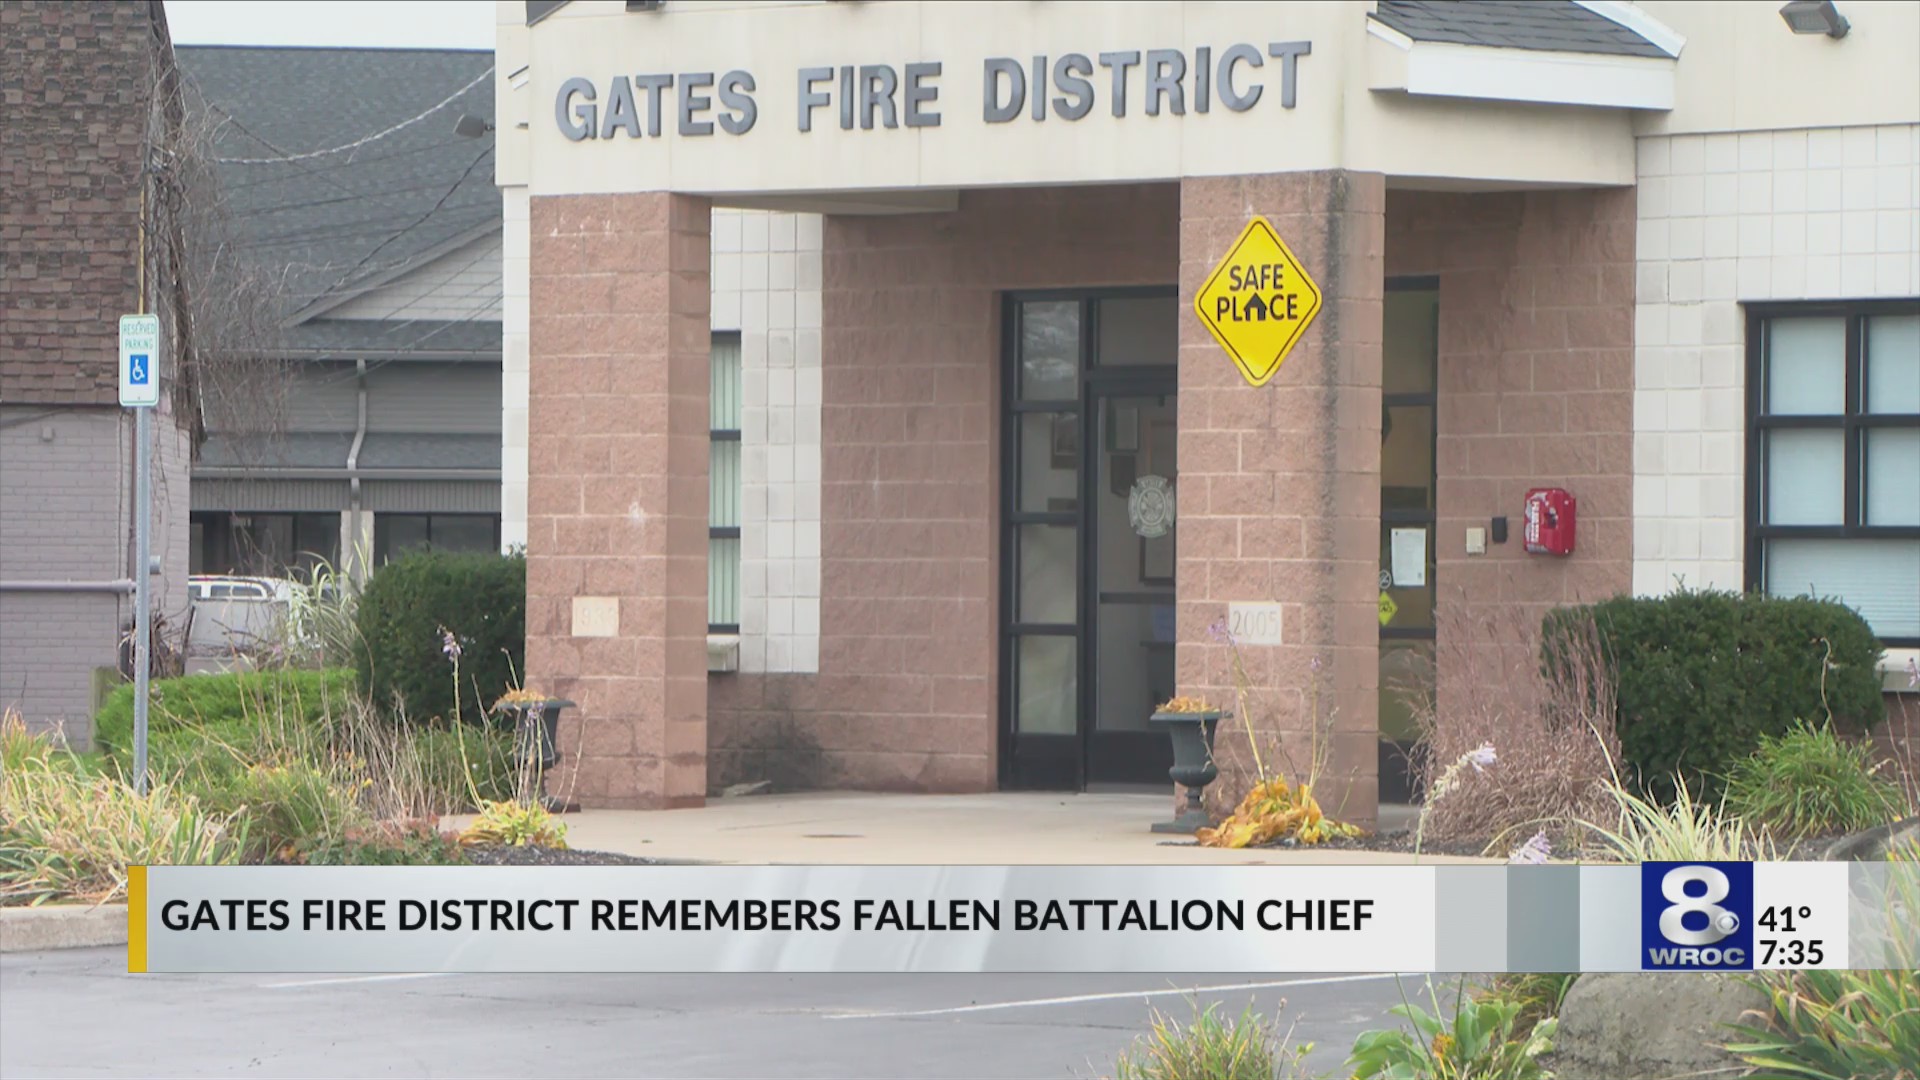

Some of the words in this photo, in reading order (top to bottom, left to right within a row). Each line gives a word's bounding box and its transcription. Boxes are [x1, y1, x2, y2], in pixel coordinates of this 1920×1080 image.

[555, 70, 758, 142] GATES
[797, 61, 943, 133] FIRE
[983, 40, 1313, 125] DISTRICT
[1229, 264, 1284, 291] SAFE
[125, 338, 153, 350] PARKING
[1232, 610, 1277, 637] 2005
